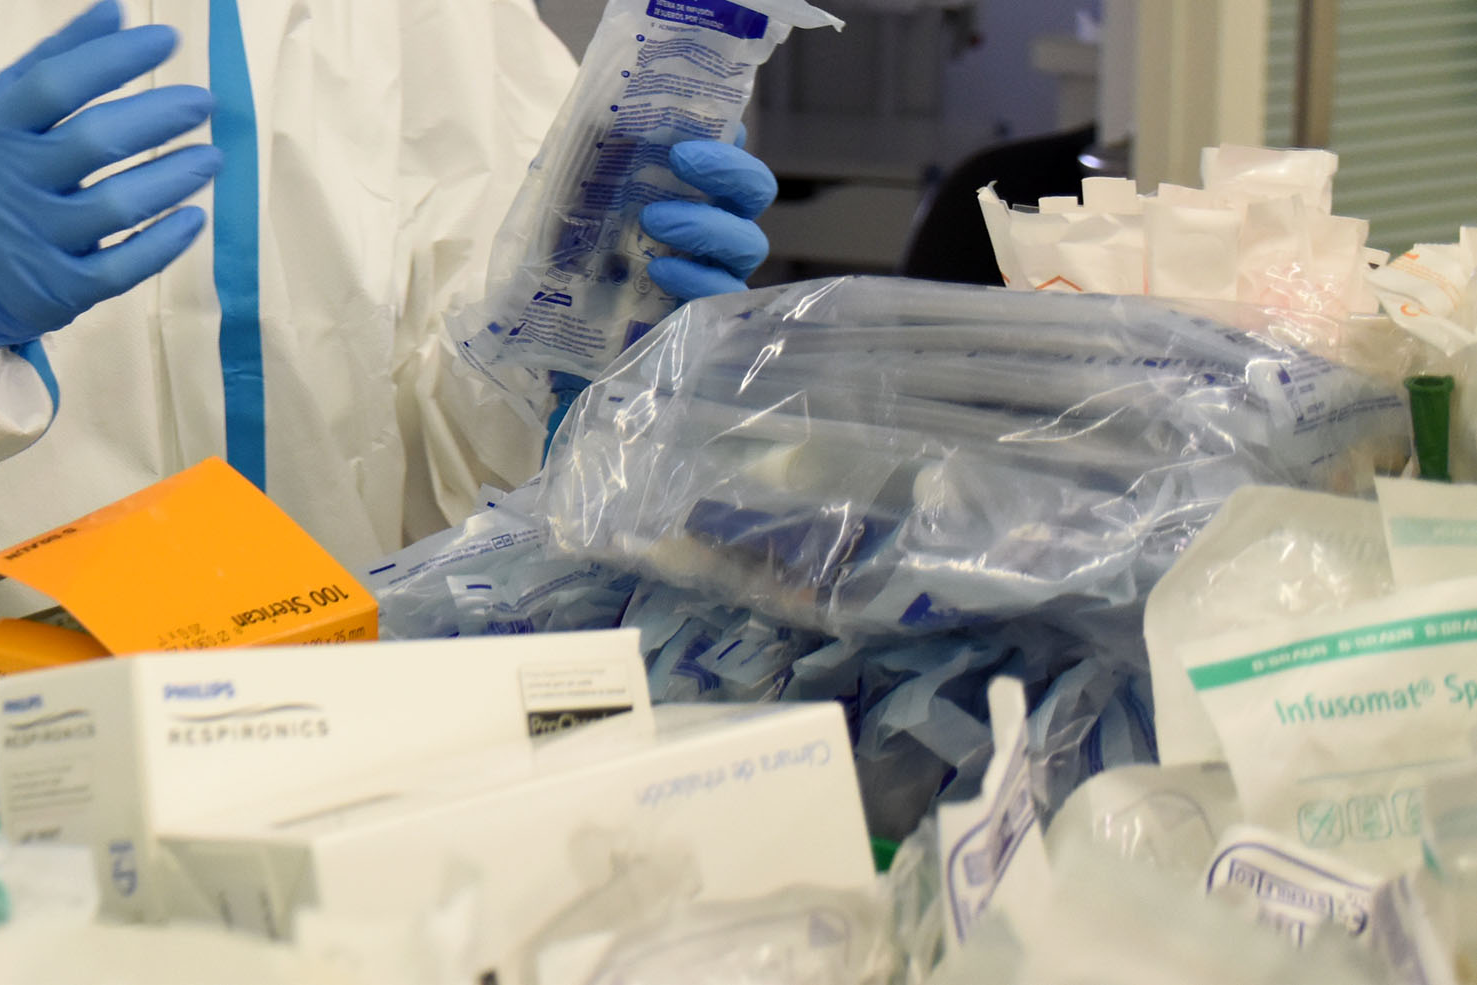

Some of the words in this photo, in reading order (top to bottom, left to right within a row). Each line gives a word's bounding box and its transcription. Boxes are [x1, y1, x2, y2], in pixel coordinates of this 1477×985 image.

[309, 584, 349, 607] 100
[348, 625, 366, 639] mm
[164, 681, 235, 702] PHILIPS
[167, 719, 330, 747] RESPIRONICS
